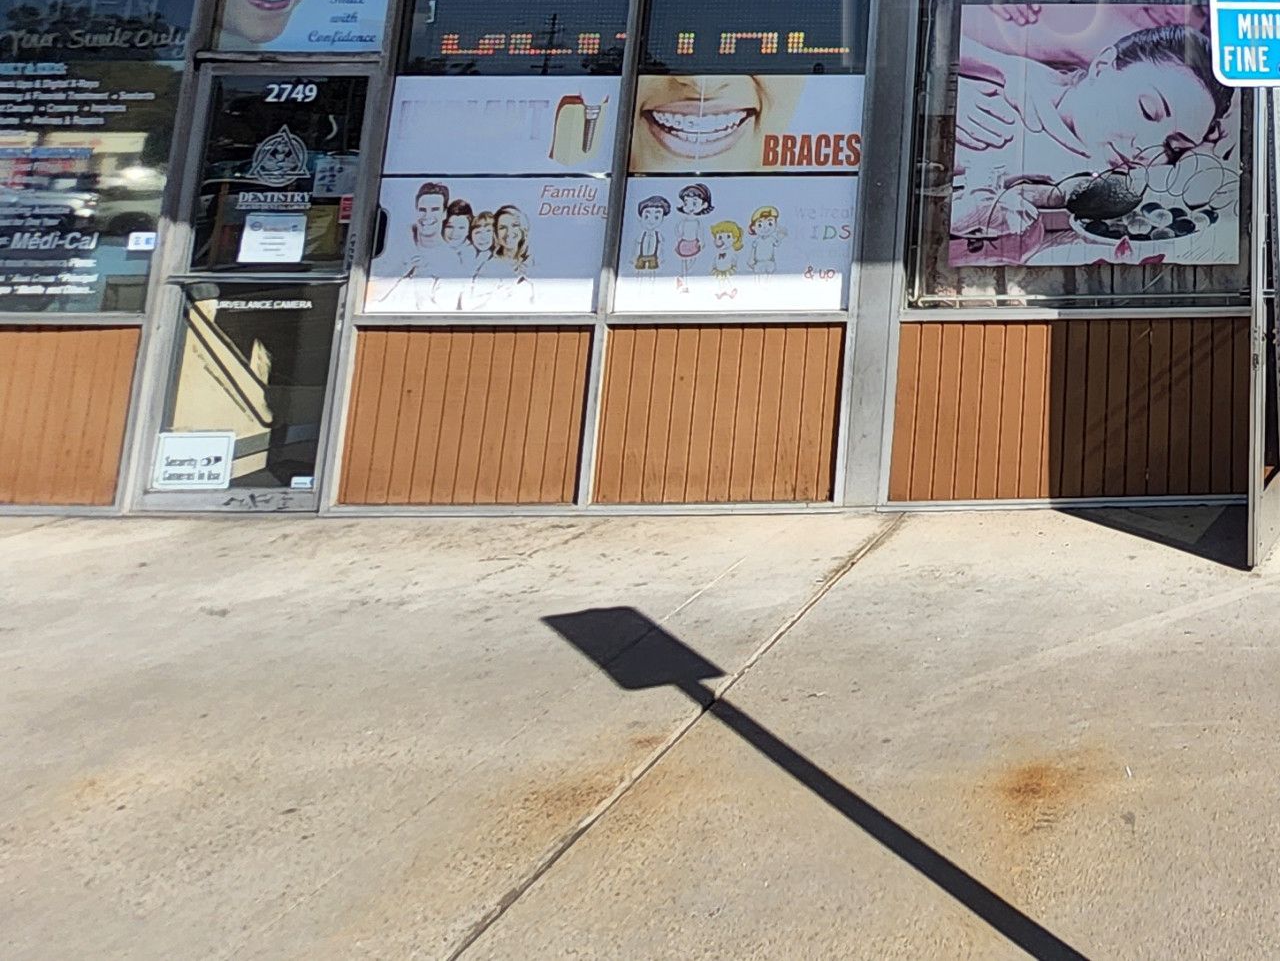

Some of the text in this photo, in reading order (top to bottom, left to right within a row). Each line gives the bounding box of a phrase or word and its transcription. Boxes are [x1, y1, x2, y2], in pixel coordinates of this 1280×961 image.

[308, 30, 376, 46] Confidence
[1224, 45, 1269, 73] FINE
[264, 83, 318, 103] 2749
[762, 134, 862, 166] BRACES
[239, 191, 312, 203] DENTISTRY
[540, 184, 598, 202] Family
[538, 202, 608, 219] Dentistry
